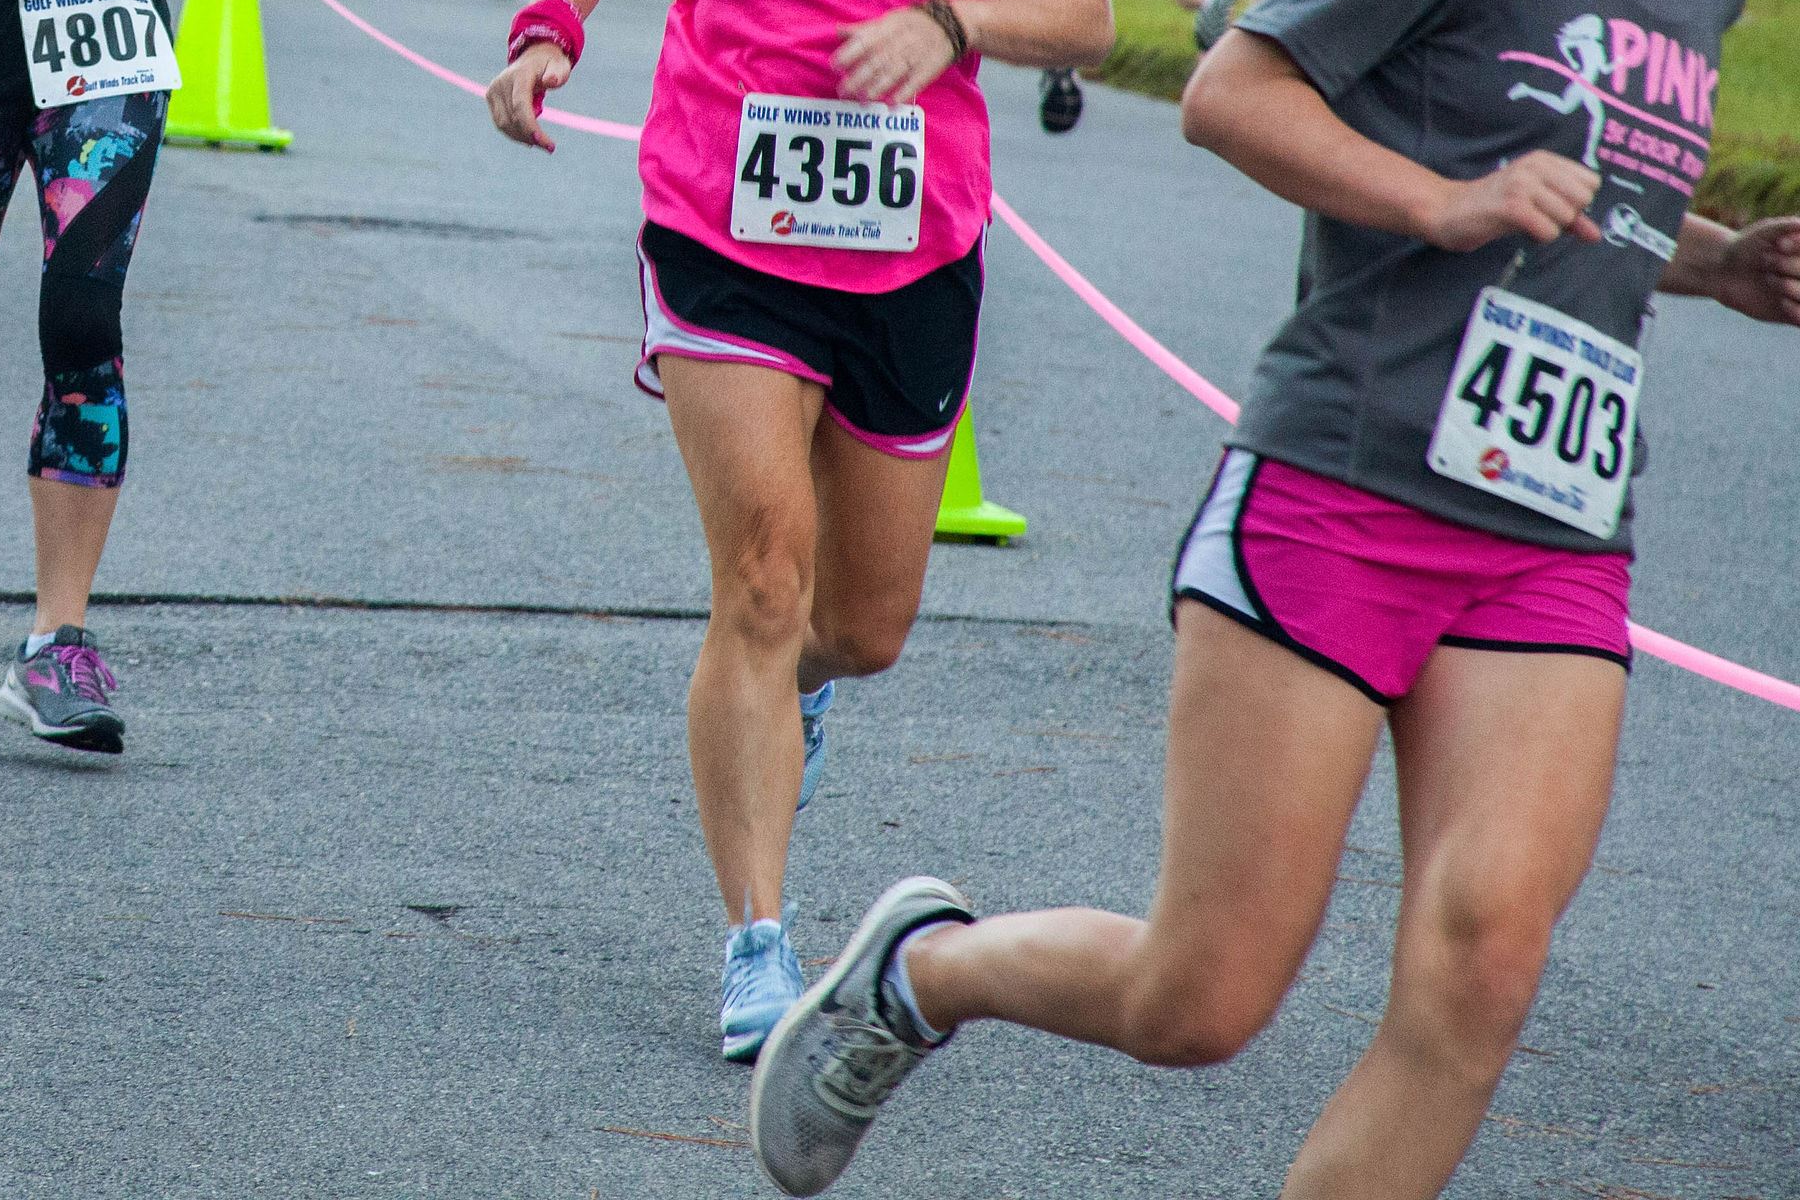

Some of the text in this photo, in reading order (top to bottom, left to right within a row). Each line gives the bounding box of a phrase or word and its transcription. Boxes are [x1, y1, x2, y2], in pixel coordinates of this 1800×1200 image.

[32, 6, 157, 73] 4807
[99, 78, 119, 89] Winds
[121, 75, 138, 86] Track
[140, 73, 155, 84] Club
[747, 104, 920, 132] GULF WINDS TRACK CLUB
[741, 133, 918, 209] 4356
[811, 222, 835, 237] Winds
[838, 224, 860, 237] Track
[862, 225, 881, 239] Club
[1458, 340, 1627, 480] 4503
